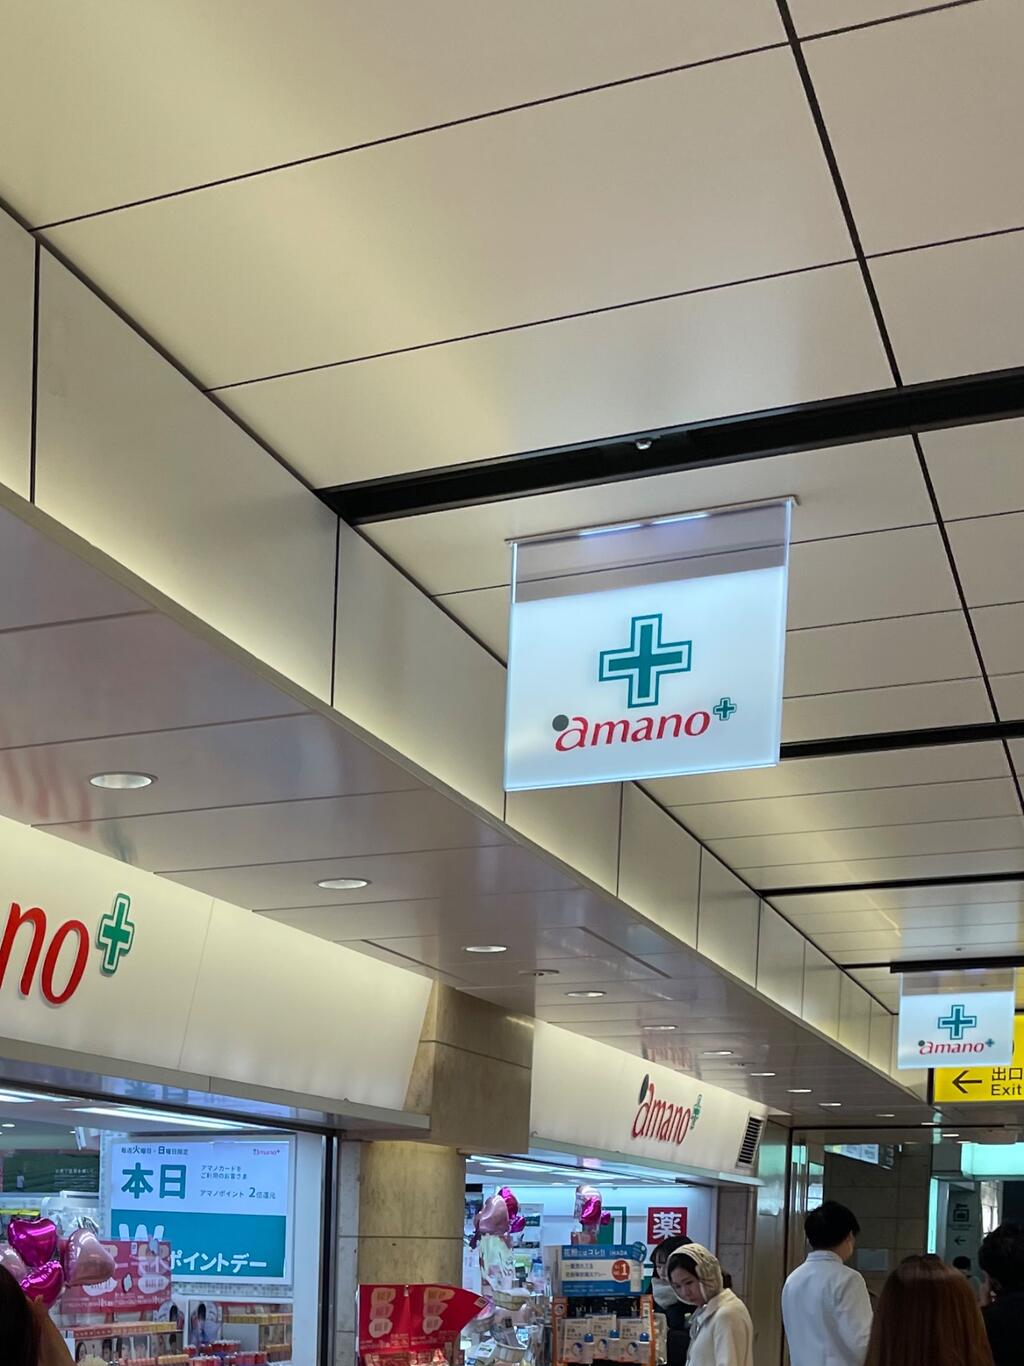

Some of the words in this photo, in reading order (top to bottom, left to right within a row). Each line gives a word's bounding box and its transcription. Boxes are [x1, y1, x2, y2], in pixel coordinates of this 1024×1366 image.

[992, 1067, 1023, 1081] 出口
[991, 1084, 1022, 1096] Exit
[121, 1162, 187, 1199] 本日
[652, 1211, 682, 1240] 薬
